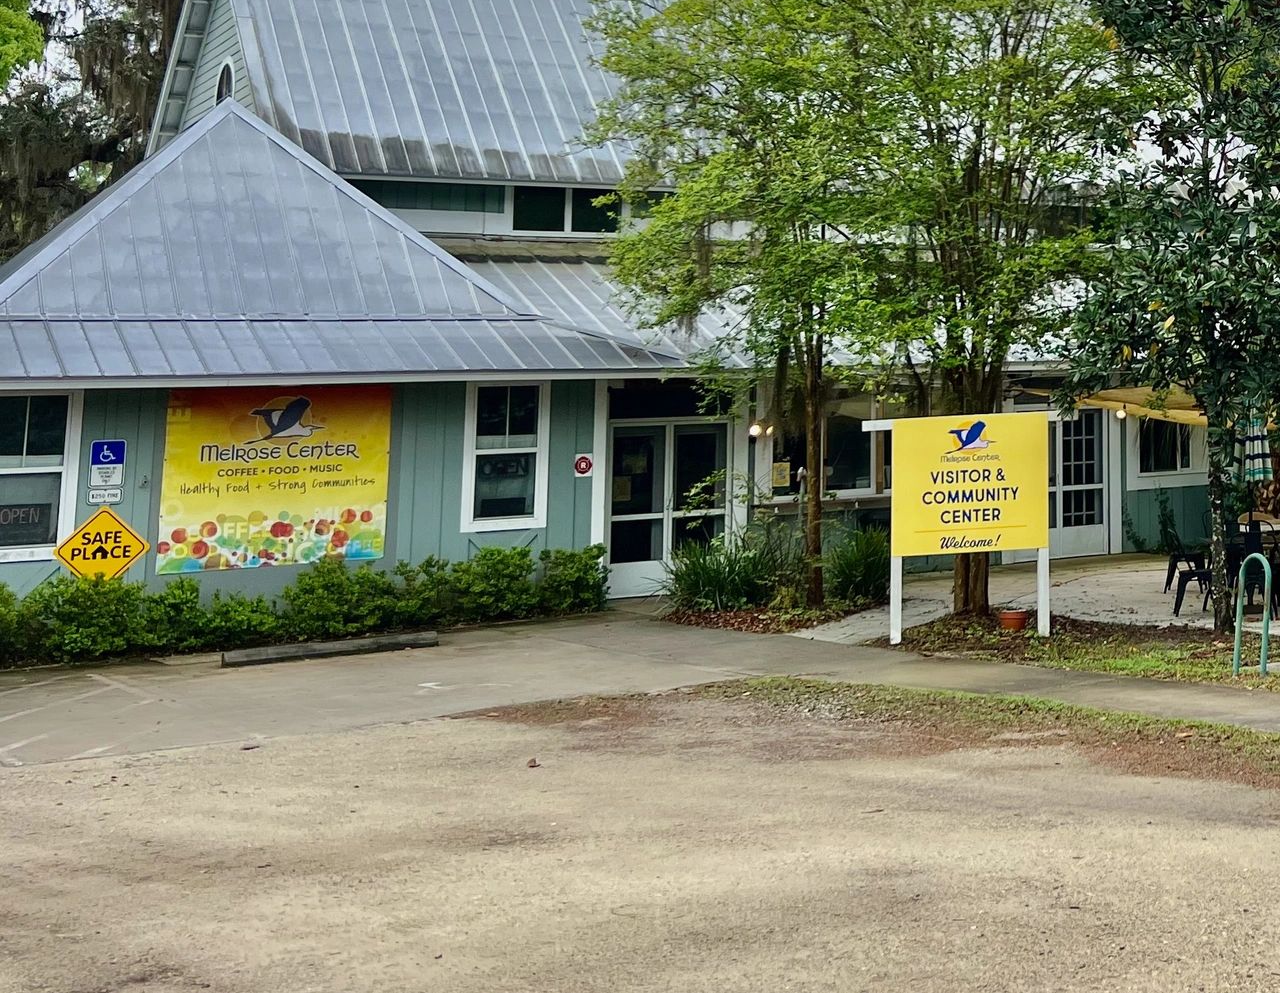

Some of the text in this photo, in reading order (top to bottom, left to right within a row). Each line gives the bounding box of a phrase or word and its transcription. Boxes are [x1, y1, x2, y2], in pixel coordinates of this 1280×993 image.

[217, 463, 343, 478] COFFEE FOOD MUSIC
[930, 468, 1006, 485] VISITOR &
[180, 483, 220, 497] Healthy
[226, 480, 250, 494] Food
[269, 478, 307, 494] Strong
[312, 475, 376, 489] Communities
[922, 486, 1019, 505] COMMUNITY
[0, 507, 41, 525] OPEN
[940, 508, 1001, 524] CENTER
[81, 530, 123, 545] SAFE
[939, 534, 1002, 550] Welcome!
